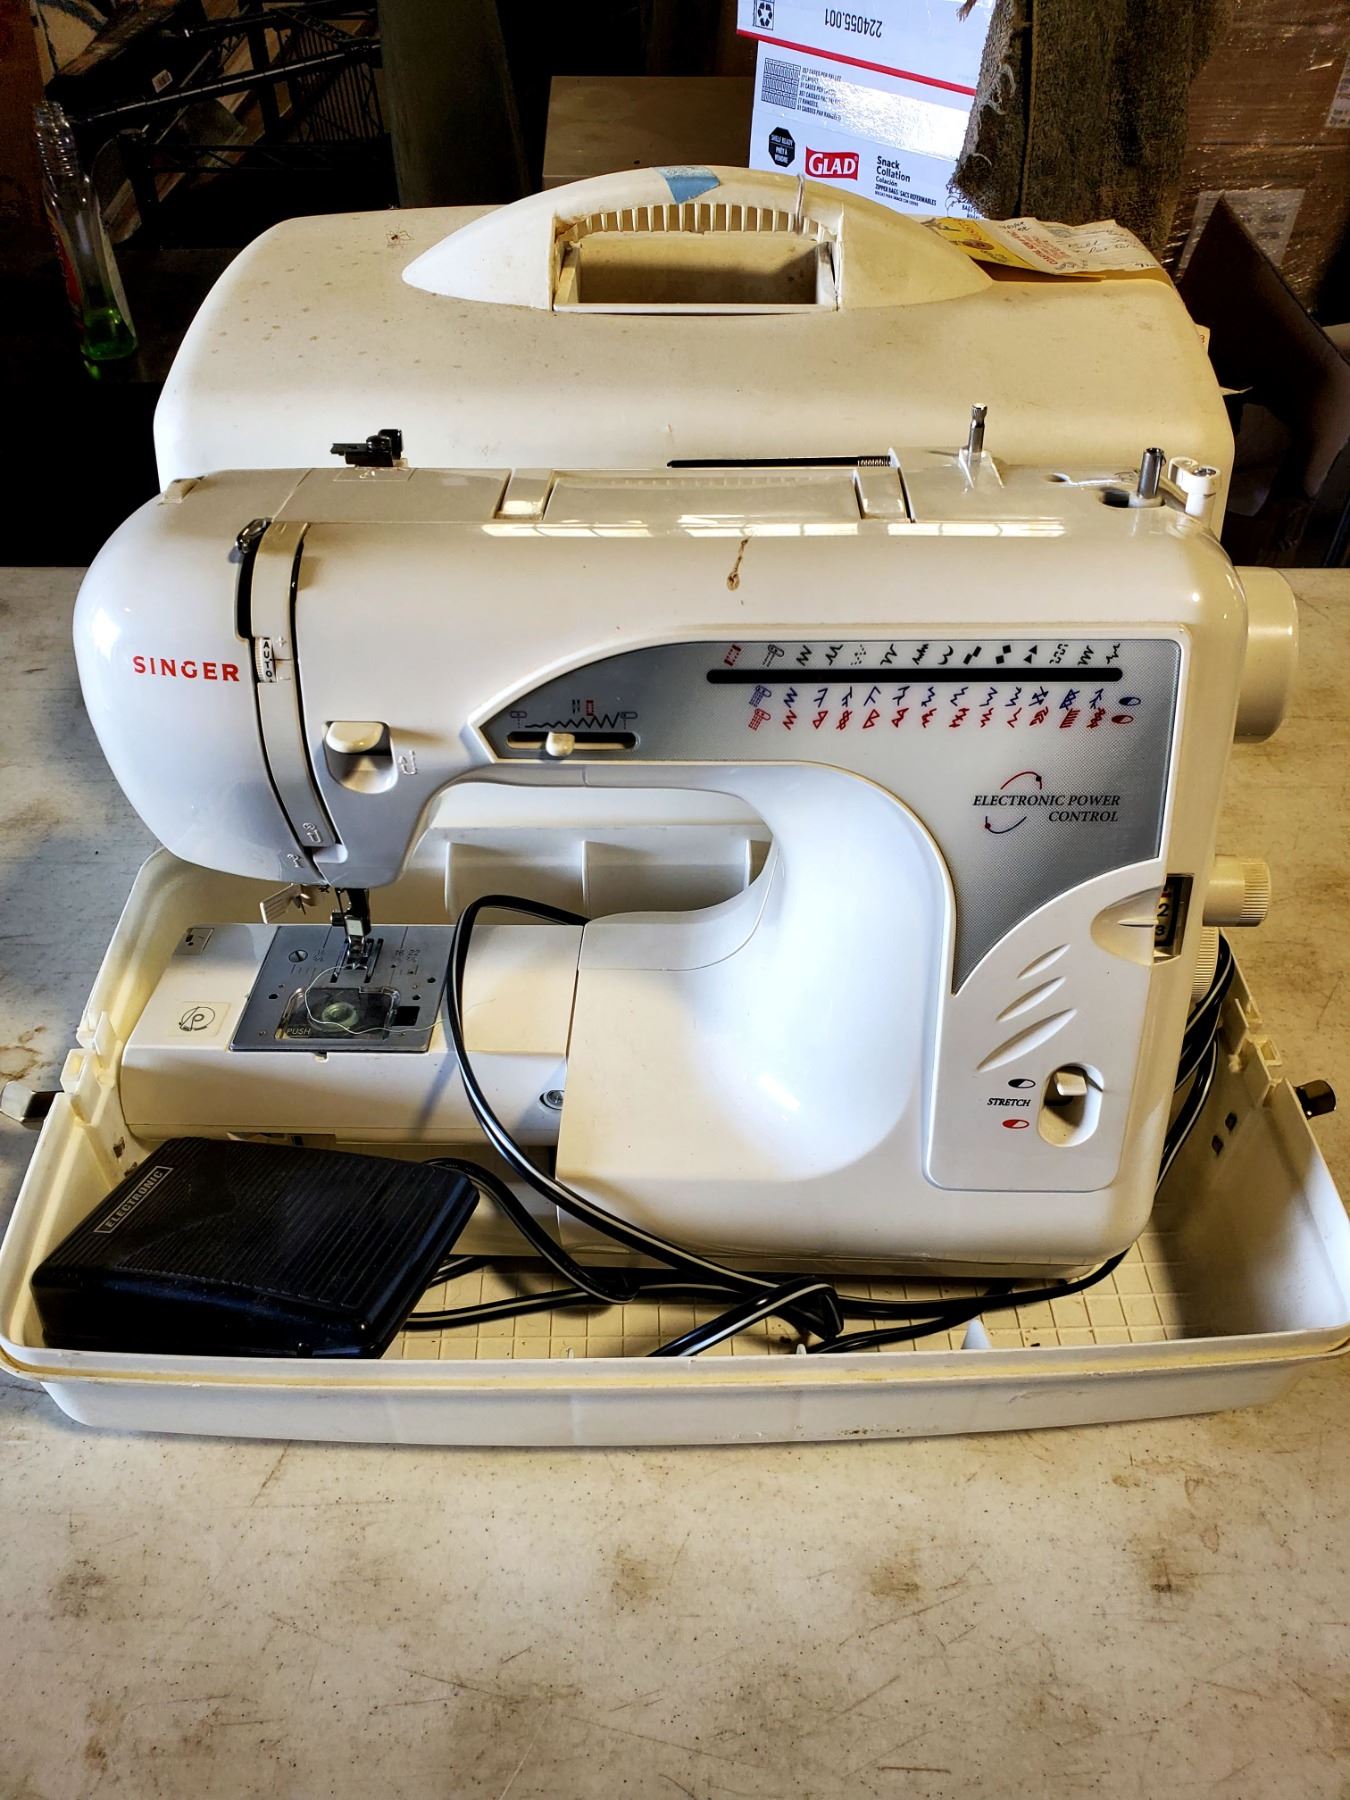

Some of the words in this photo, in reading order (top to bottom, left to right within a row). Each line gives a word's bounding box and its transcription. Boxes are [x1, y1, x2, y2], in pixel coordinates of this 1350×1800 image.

[824, 8, 882, 38] 224055.001
[808, 154, 856, 175] GLAD
[877, 156, 900, 169] Snack
[877, 166, 910, 182] Collation
[876, 176, 897, 186] Colación
[264, 641, 273, 678] AUTO
[132, 656, 240, 682] SINGER
[973, 795, 1066, 806] ELECTRONIC
[1067, 795, 1121, 806] POWER
[1048, 811, 1119, 822] CONTROL
[1158, 904, 1169, 917] 2
[1156, 925, 1166, 936] 3
[286, 1028, 311, 1036] PUSH
[987, 1098, 1031, 1107] STRETCH
[105, 1171, 163, 1228] ELECTRONIC
